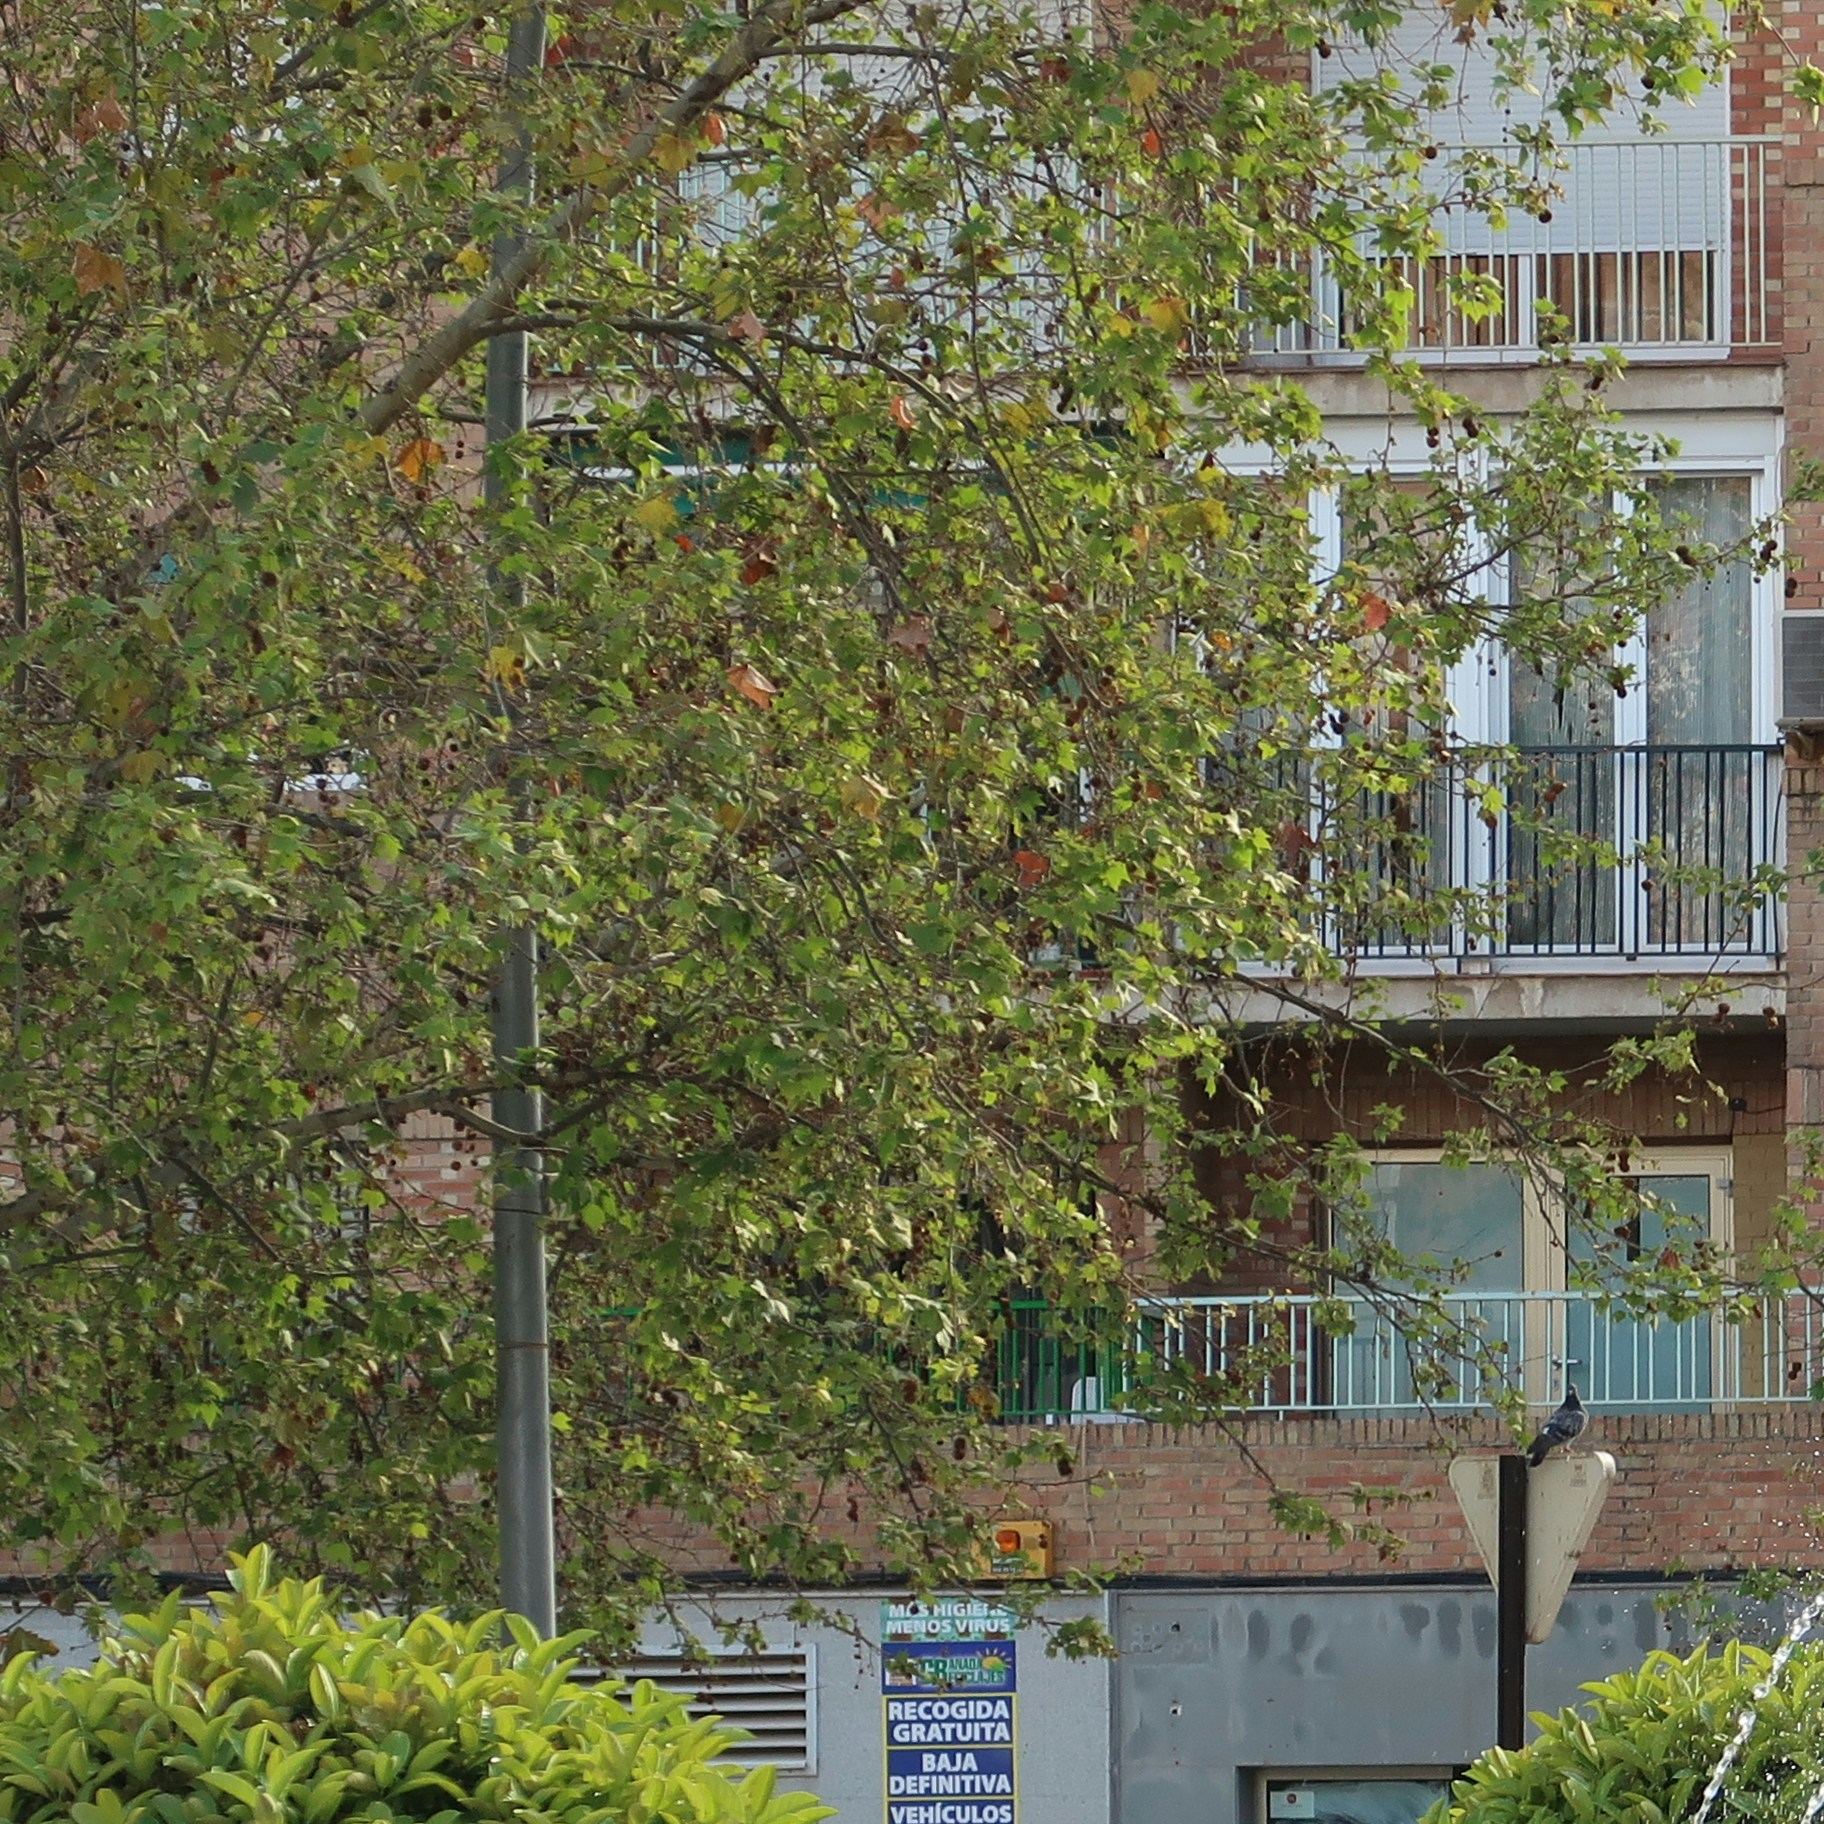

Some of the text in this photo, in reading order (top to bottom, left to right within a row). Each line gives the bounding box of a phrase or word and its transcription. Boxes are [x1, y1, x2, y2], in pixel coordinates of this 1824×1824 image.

[886, 1618, 1010, 1634] MENOS VIRUS
[888, 1700, 1010, 1721] RECOGIDA
[893, 1722, 1011, 1742] GRATUITA
[922, 1752, 978, 1773] BAJA
[889, 1774, 1012, 1795] DEFINITIVA
[890, 1802, 1012, 1824] VEHÍCULOS
